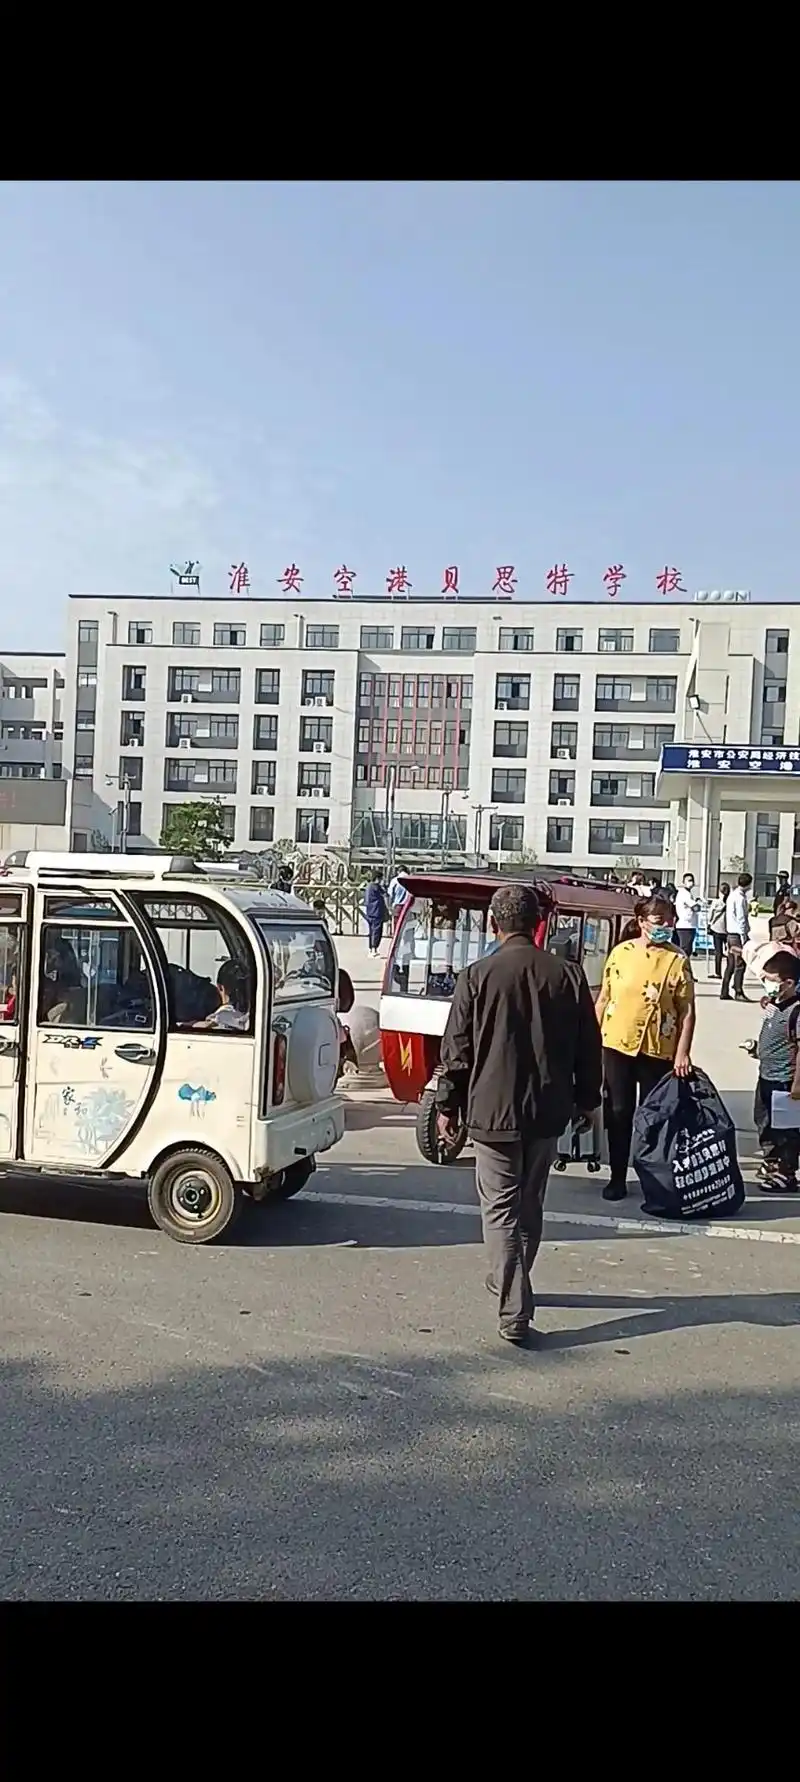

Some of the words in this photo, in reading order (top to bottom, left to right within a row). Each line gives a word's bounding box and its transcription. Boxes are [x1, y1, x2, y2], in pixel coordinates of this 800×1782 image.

[228, 562, 688, 596] 淮安空港贝思特学校
